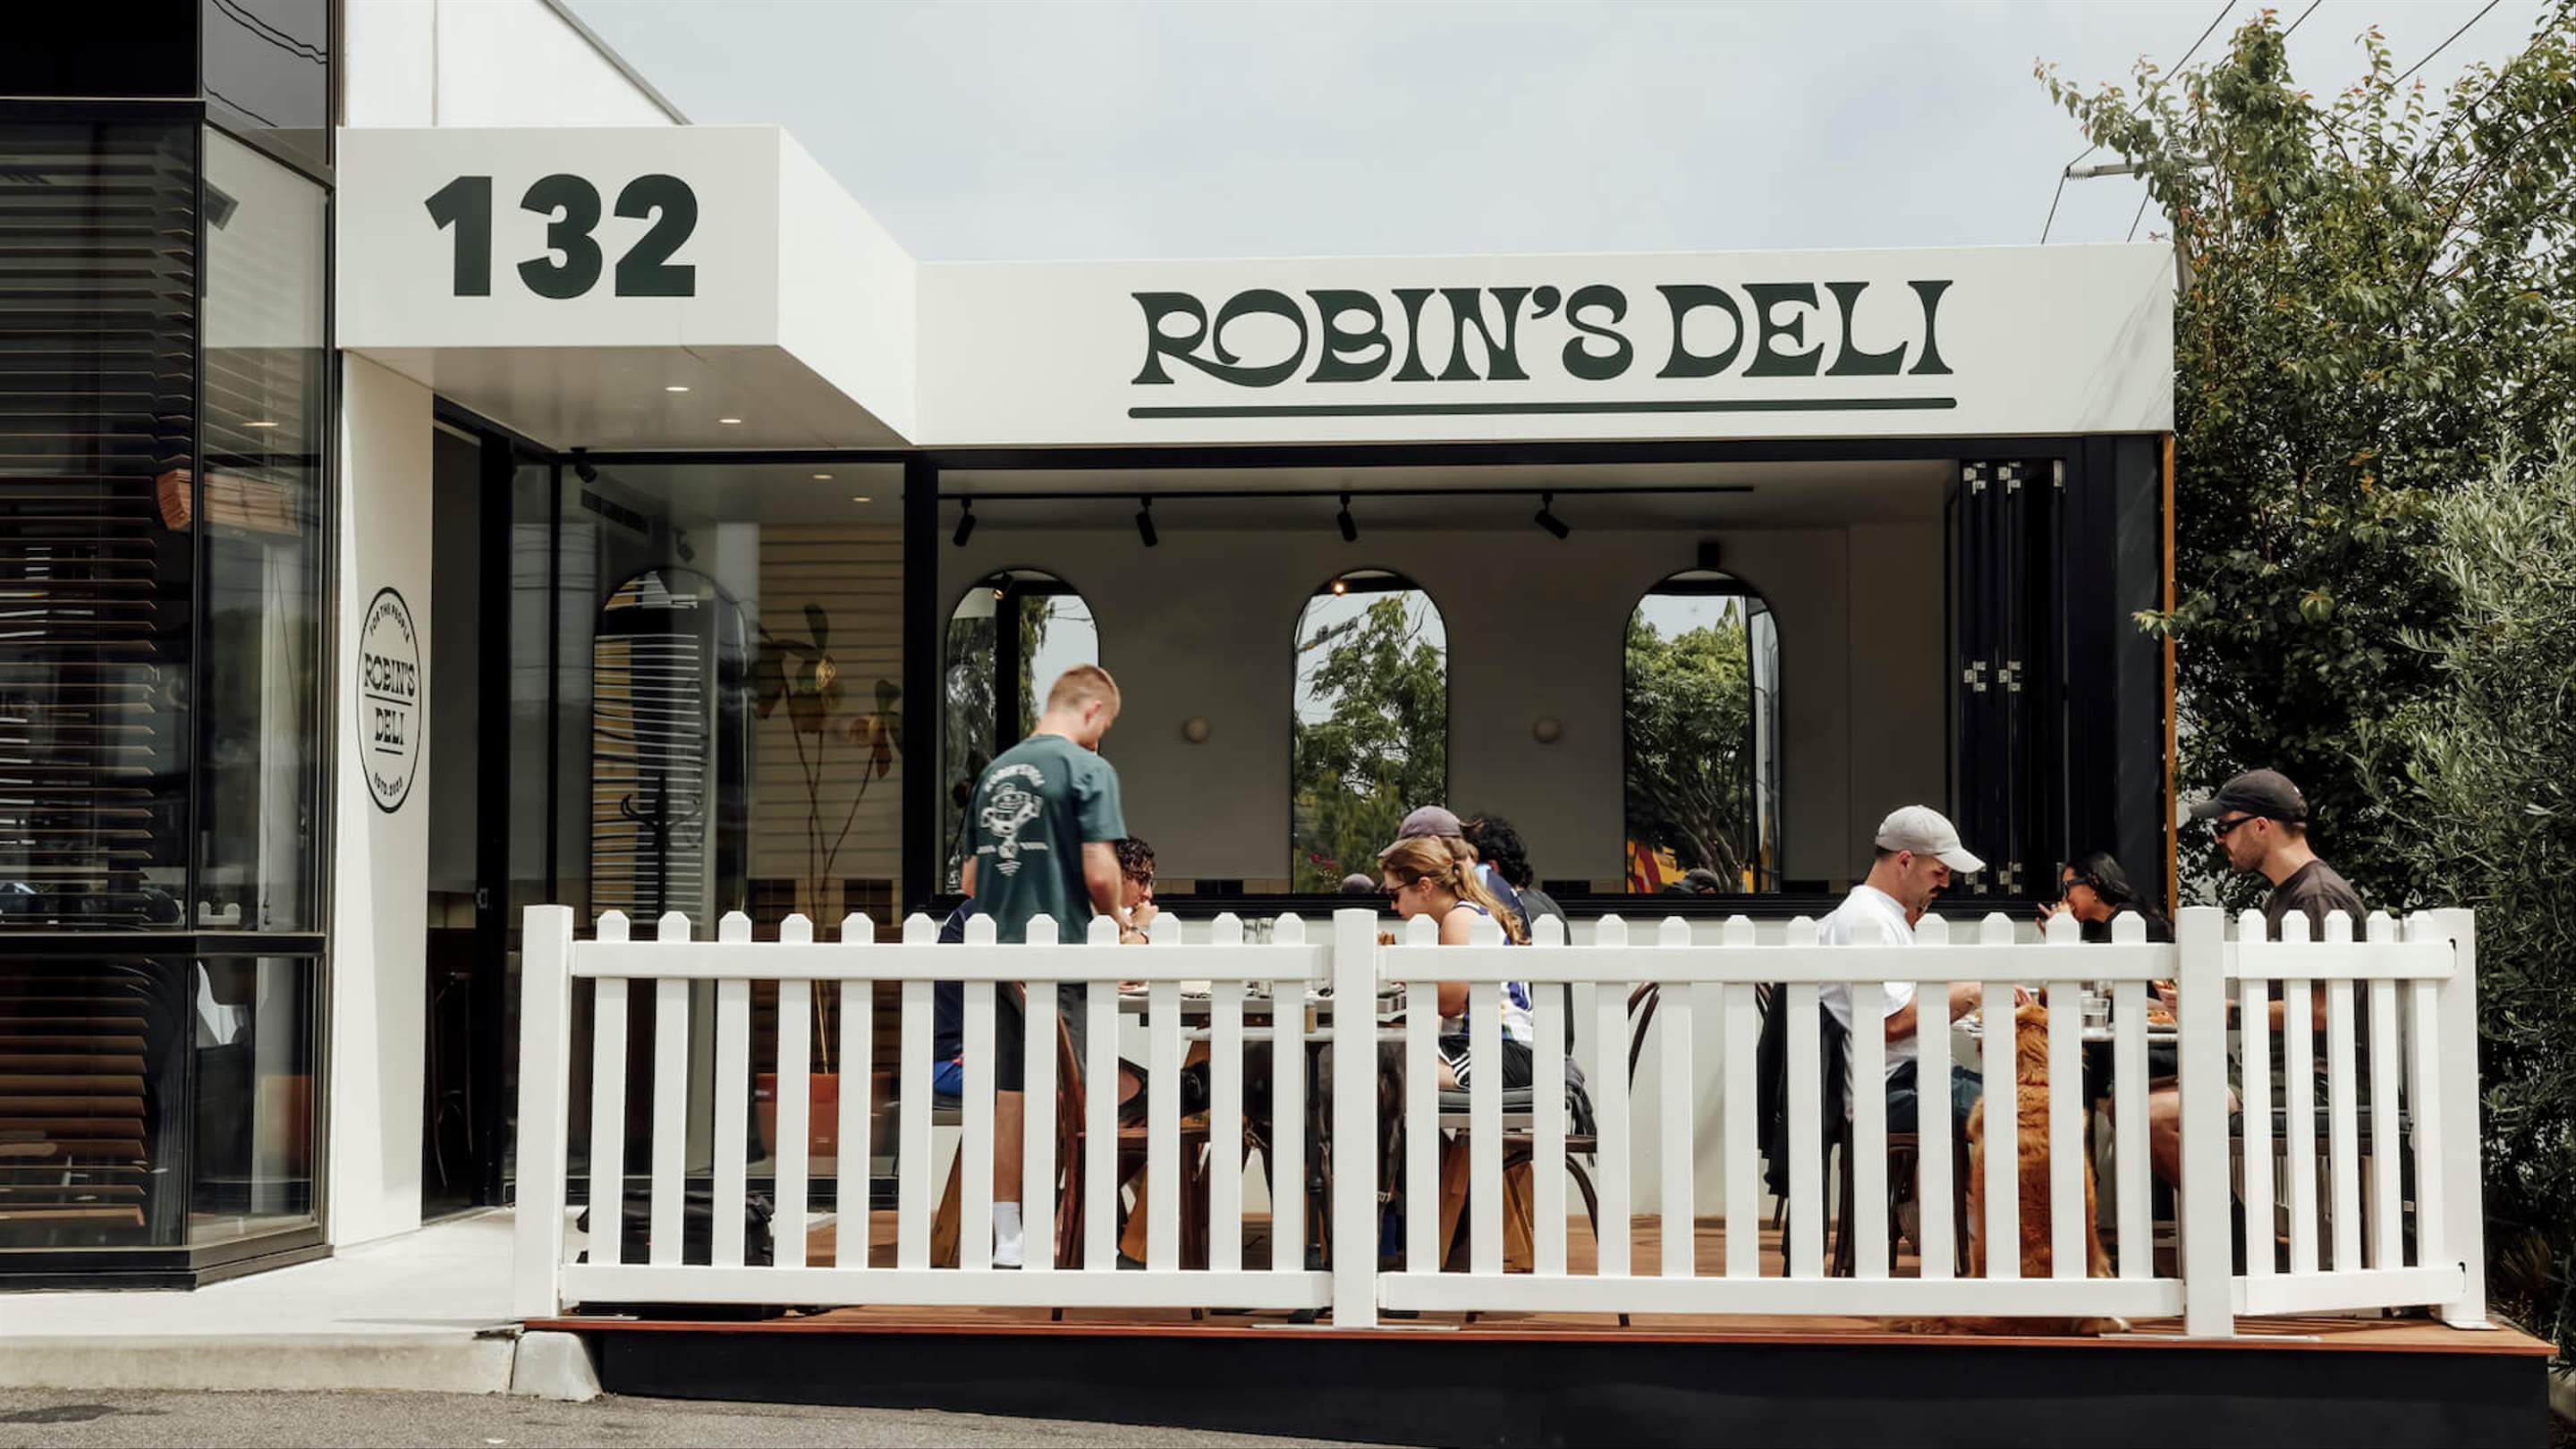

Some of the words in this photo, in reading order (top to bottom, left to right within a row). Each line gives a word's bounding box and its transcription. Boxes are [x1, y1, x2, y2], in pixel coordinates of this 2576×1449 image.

[424, 174, 699, 300] 132
[1131, 284, 1634, 388] ROBIN'S
[1655, 279, 1954, 379] DELI
[369, 610, 380, 637] FOR
[380, 602, 391, 617] THE
[391, 604, 410, 644] PEOPLE
[364, 652, 415, 697] ROBIN'S
[375, 707, 404, 745] DELI
